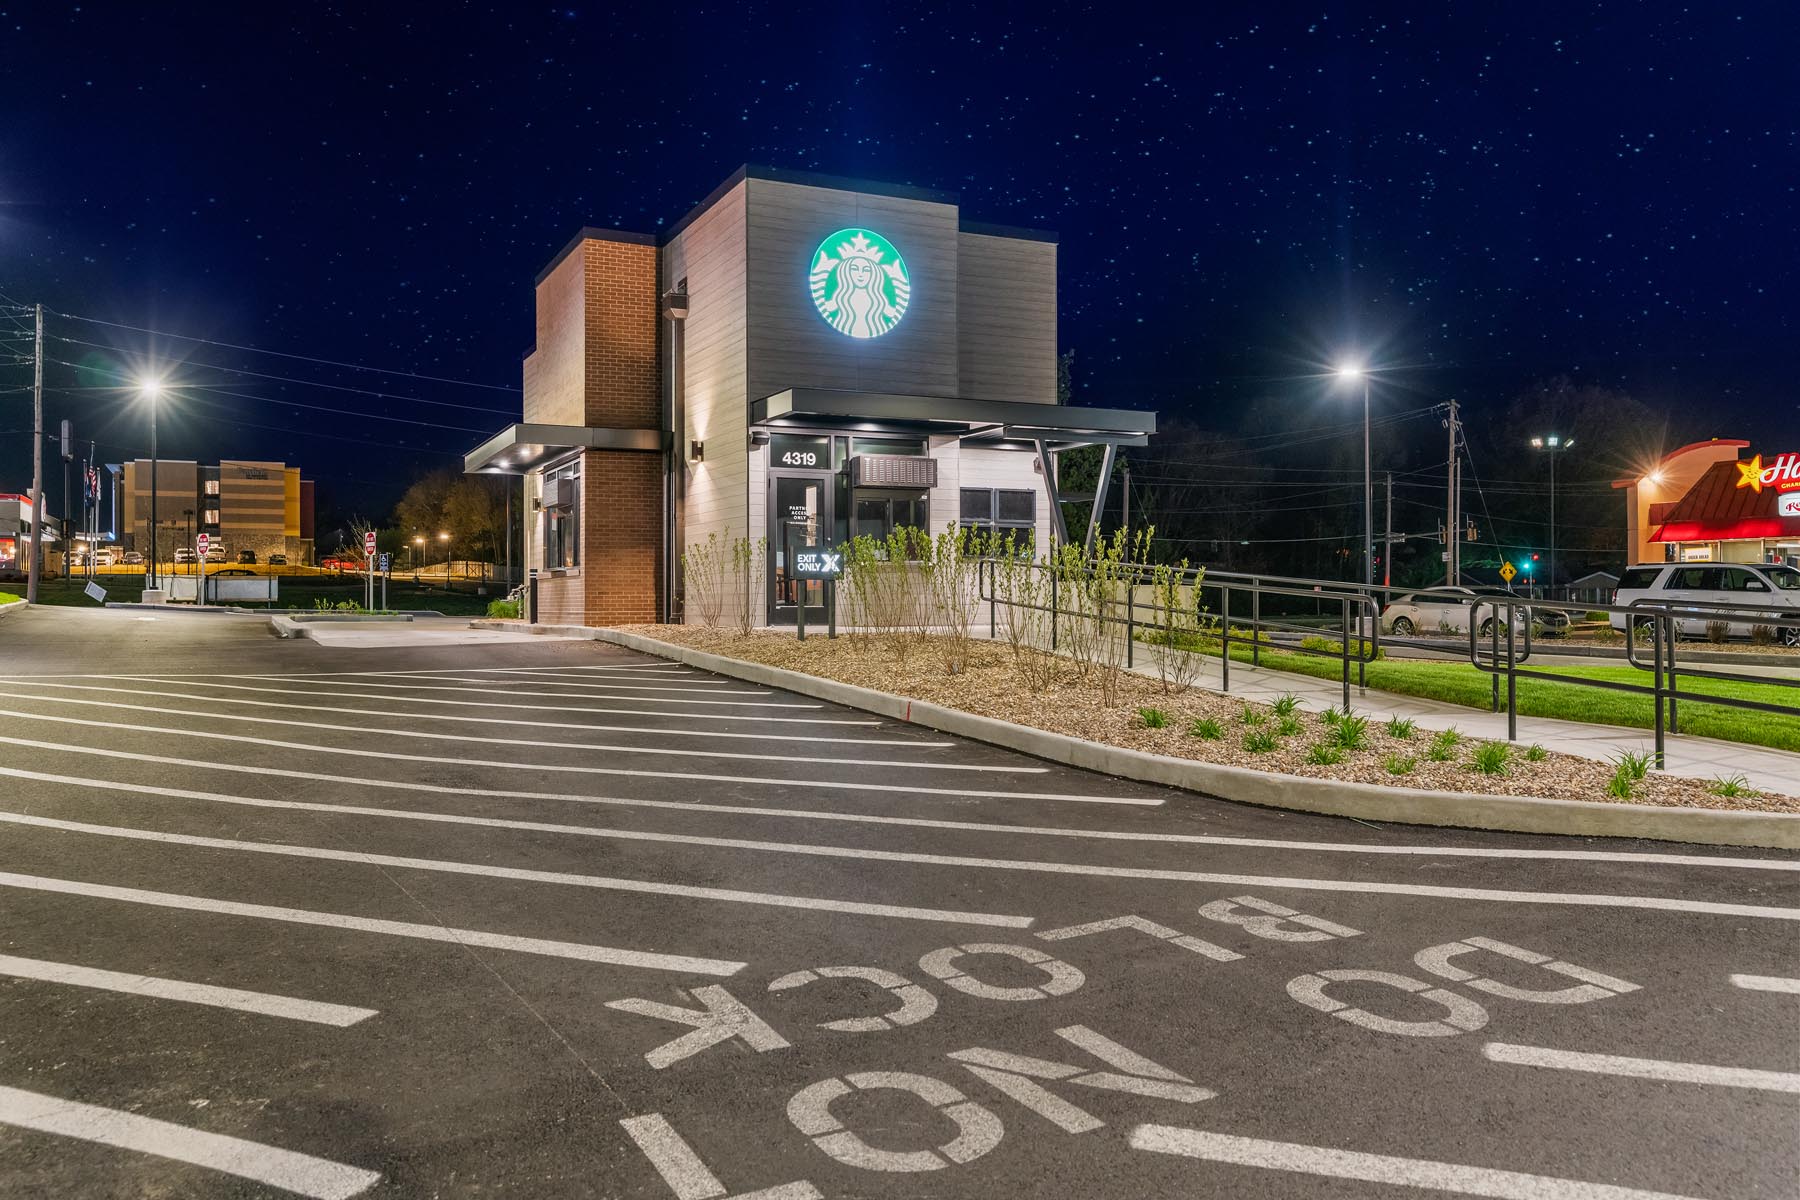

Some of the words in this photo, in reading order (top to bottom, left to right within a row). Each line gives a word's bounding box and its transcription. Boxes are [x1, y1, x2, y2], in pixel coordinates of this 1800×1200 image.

[782, 452, 816, 466] 4319
[797, 554, 817, 563] EXIT
[797, 563, 821, 572] ONLY
[603, 895, 1366, 1070] BLOCK
[1286, 936, 1645, 1037] DO
